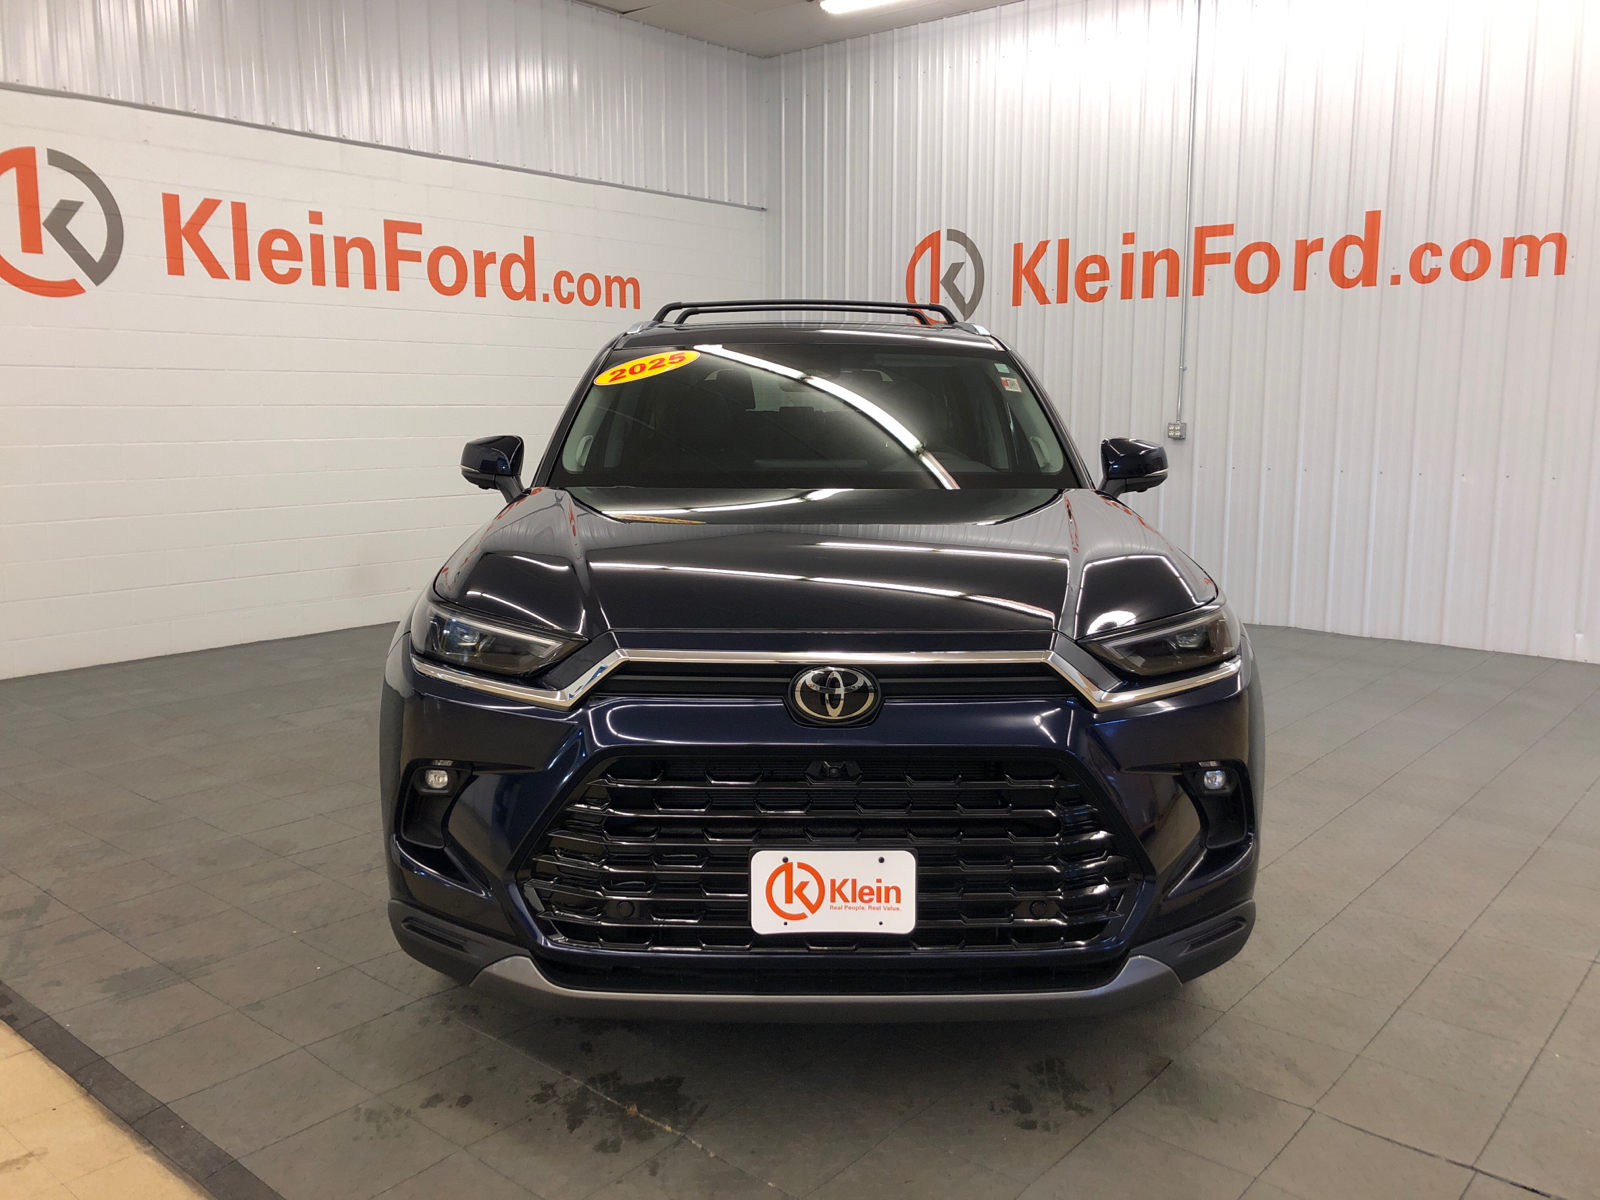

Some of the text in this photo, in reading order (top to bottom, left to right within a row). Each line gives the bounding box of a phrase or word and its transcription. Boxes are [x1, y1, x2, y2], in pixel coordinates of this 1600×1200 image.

[162, 192, 641, 310] KleinFord.com
[1011, 210, 1567, 307] KleinFord.com
[608, 352, 686, 383] 2025
[829, 878, 902, 904] Klein
[844, 904, 867, 912] People.
